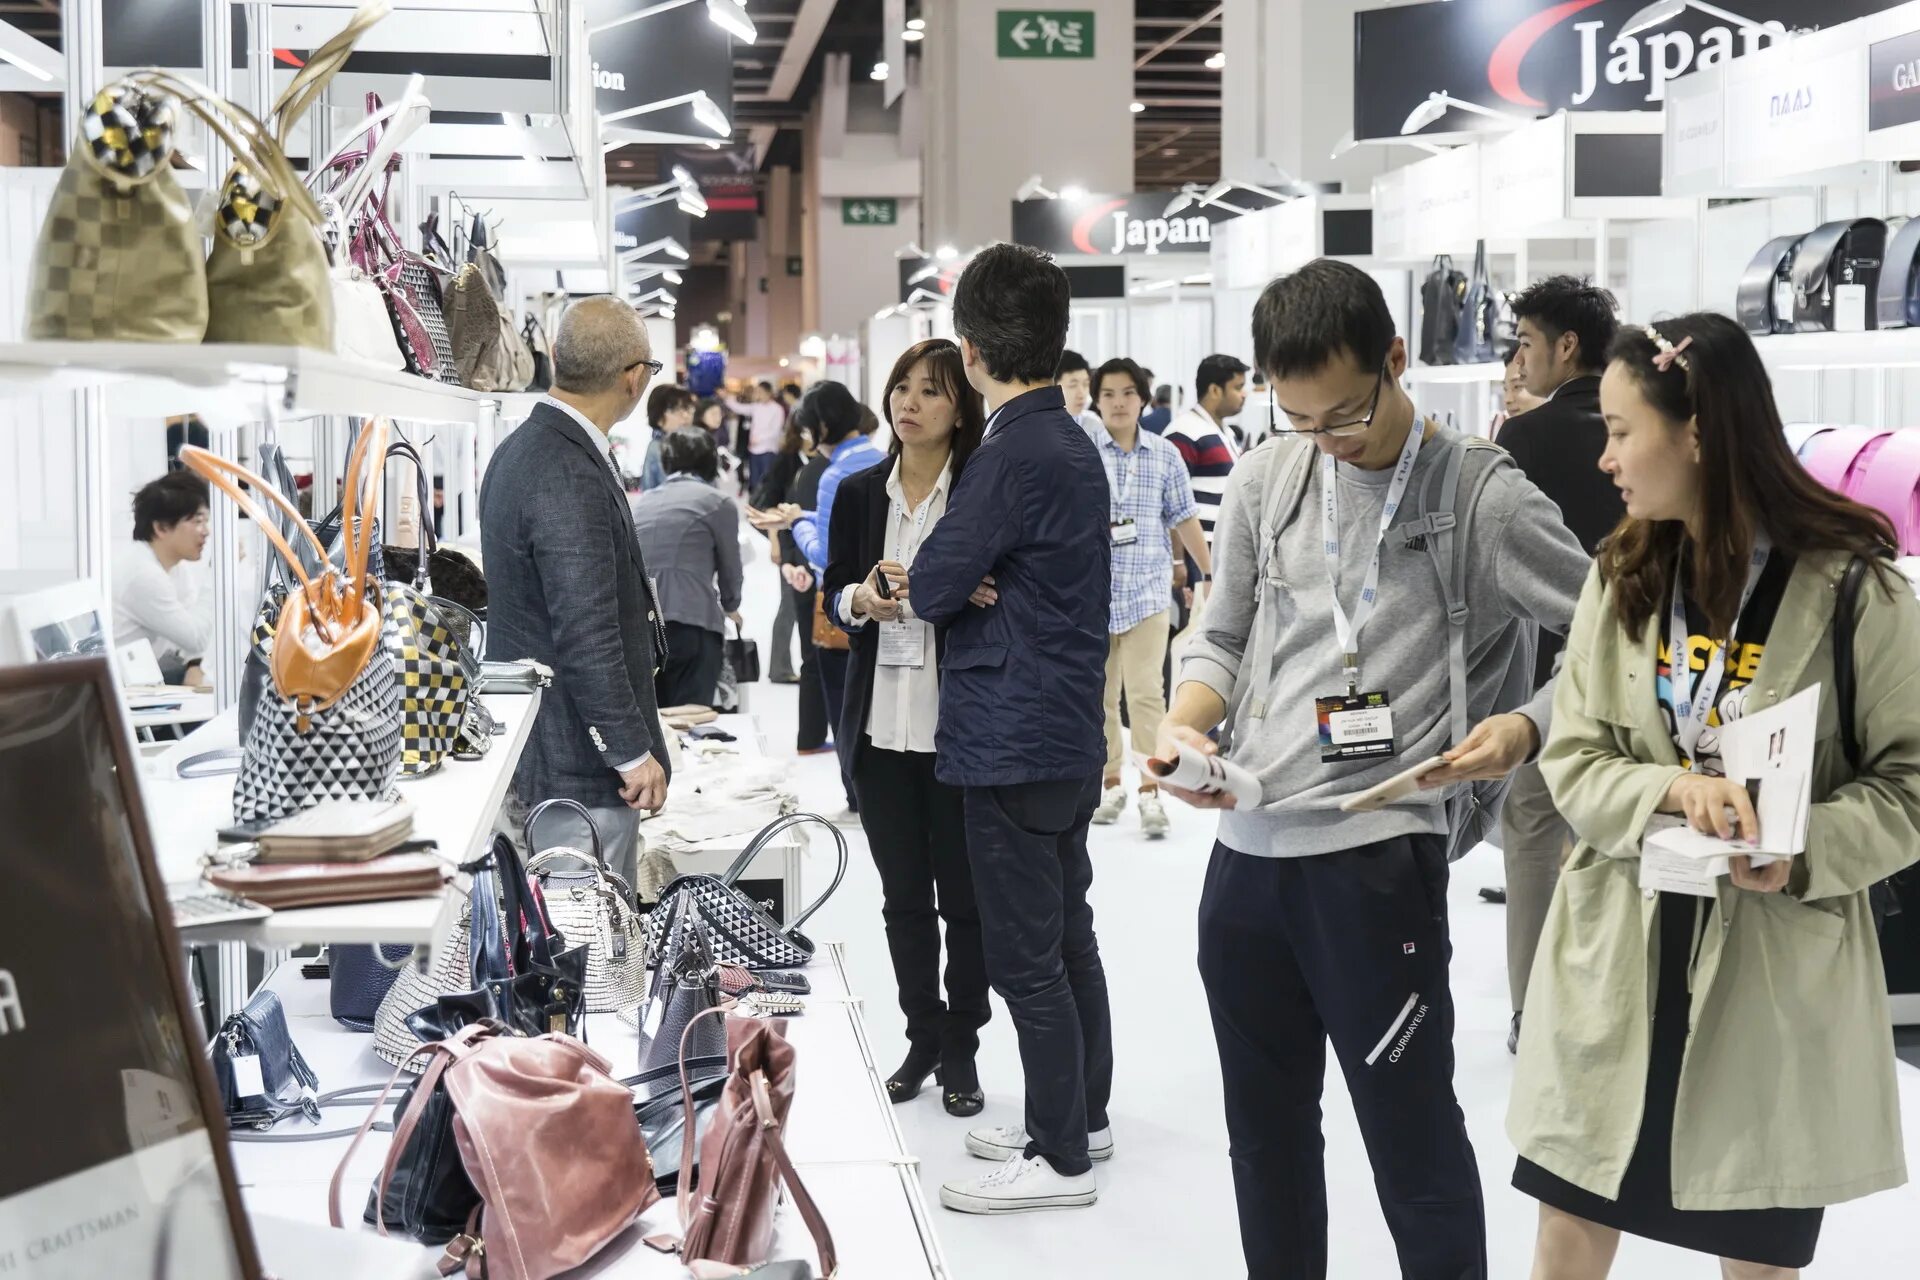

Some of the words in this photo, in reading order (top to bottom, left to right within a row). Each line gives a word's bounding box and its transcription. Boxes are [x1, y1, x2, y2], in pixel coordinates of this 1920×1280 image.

[1893, 58, 1920, 92] GA
[1111, 211, 1211, 255] Japan
[1695, 681, 1714, 724] APLF
[1388, 1004, 1430, 1063] COURMAYEUR
[26, 1202, 141, 1262] CRAFTSMAN
